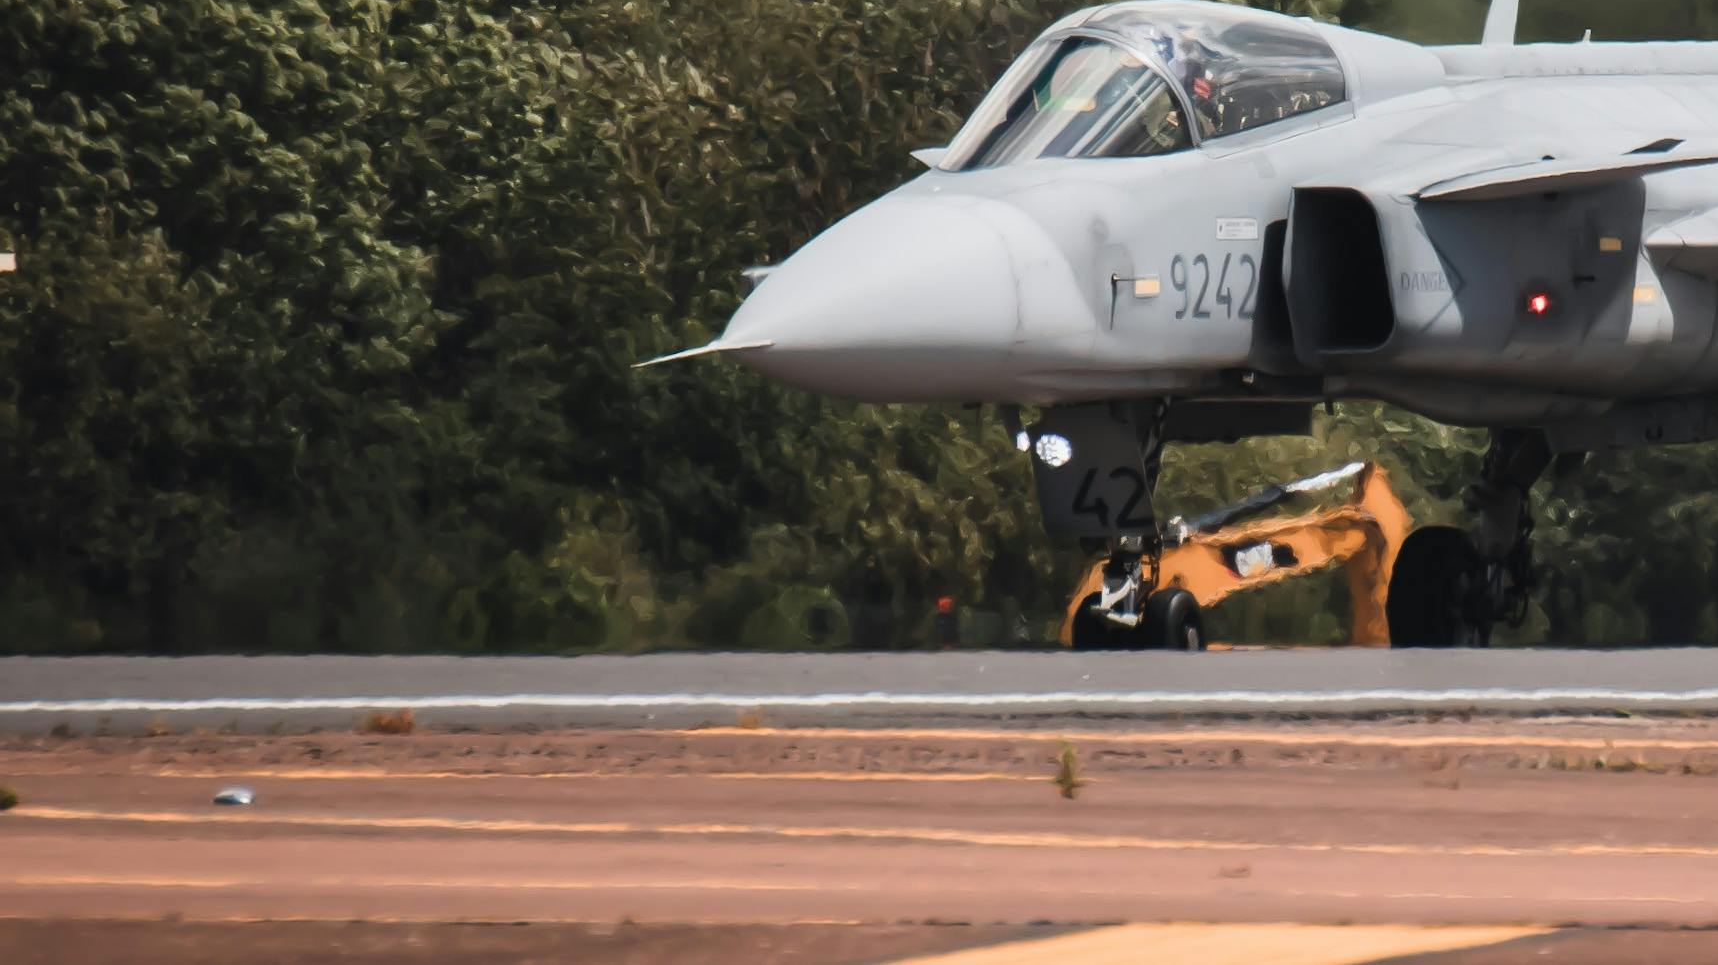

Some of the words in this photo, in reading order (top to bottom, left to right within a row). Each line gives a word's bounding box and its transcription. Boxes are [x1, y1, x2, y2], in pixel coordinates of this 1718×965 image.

[1170, 253, 1256, 320] 9242
[1400, 272, 1449, 291] DANGE
[1072, 466, 1156, 529] 42
